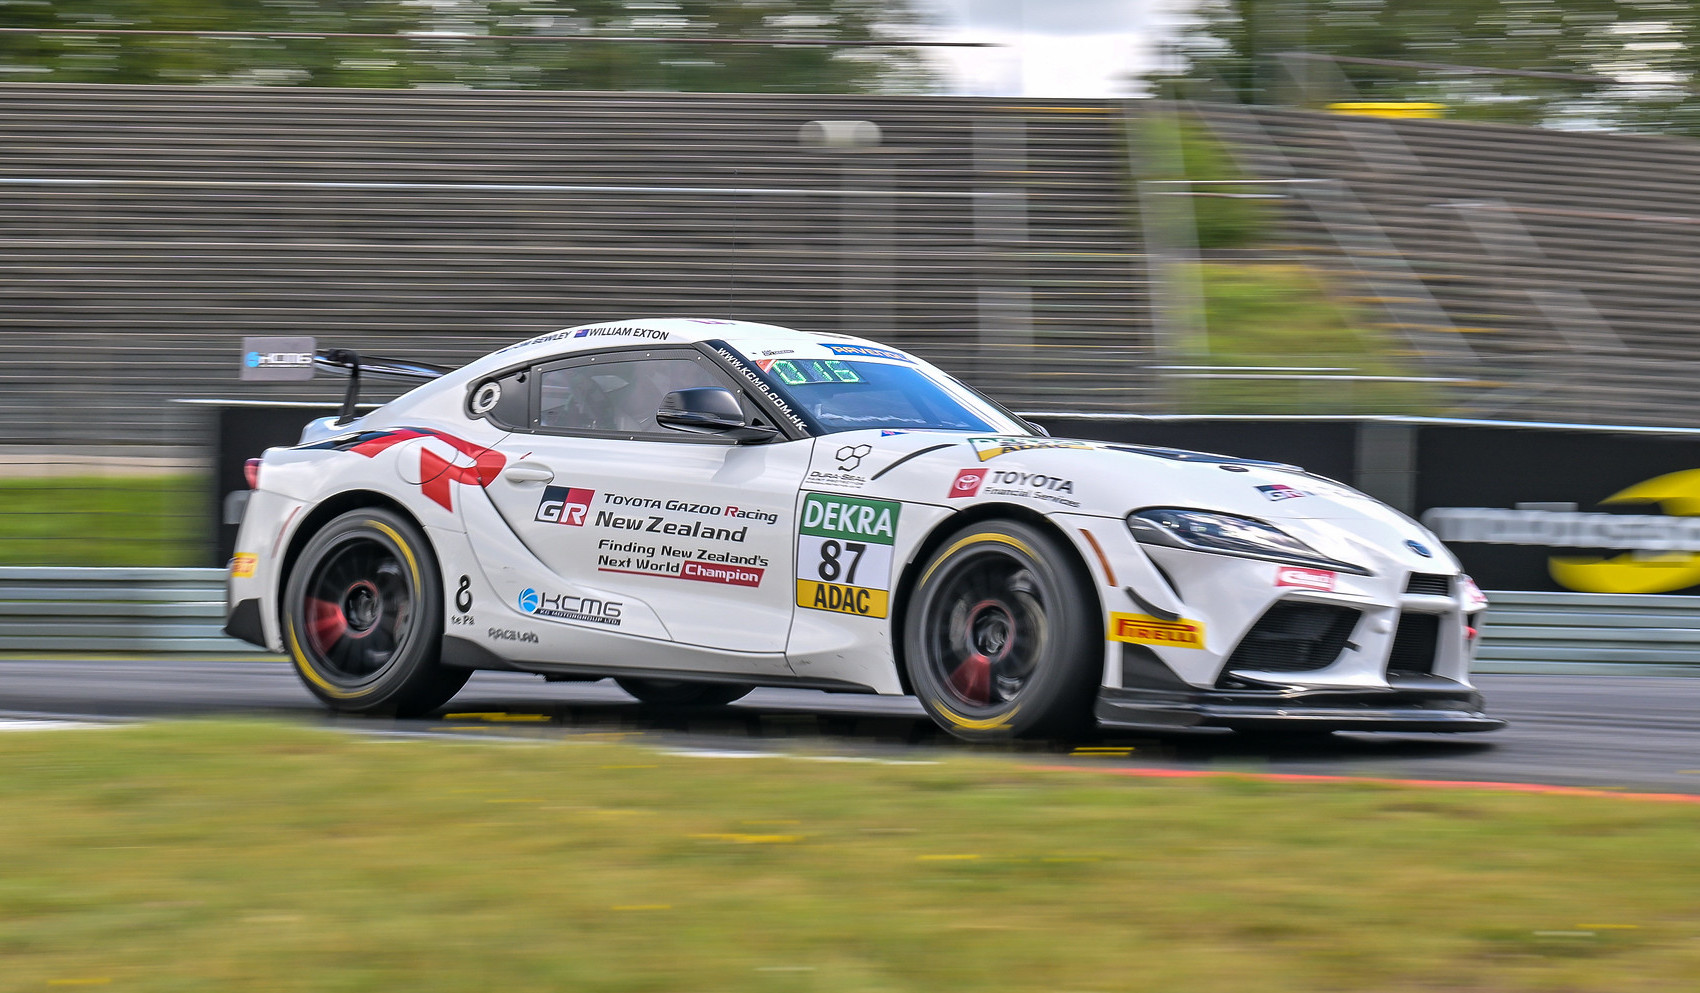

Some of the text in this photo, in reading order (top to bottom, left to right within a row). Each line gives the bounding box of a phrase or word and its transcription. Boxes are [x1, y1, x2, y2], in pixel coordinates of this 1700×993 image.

[588, 327, 670, 341] WILLIAM EXTON
[717, 347, 807, 431] WWW.KCMG.COM.HK
[992, 470, 1074, 494] TOYOTA
[604, 493, 778, 525] TOYOTA GAZOO Racing
[983, 486, 1081, 508] Financial Services
[537, 500, 587, 525] GR
[803, 500, 893, 537] DEKRA
[595, 510, 748, 543] New Zealand
[598, 539, 769, 567] Finding New Zealand's
[818, 540, 867, 584] 87
[598, 555, 759, 582] Next World Champion
[541, 592, 623, 618] KCMG
[814, 583, 870, 614] ADAC
[1116, 618, 1199, 643] PIRELLI
